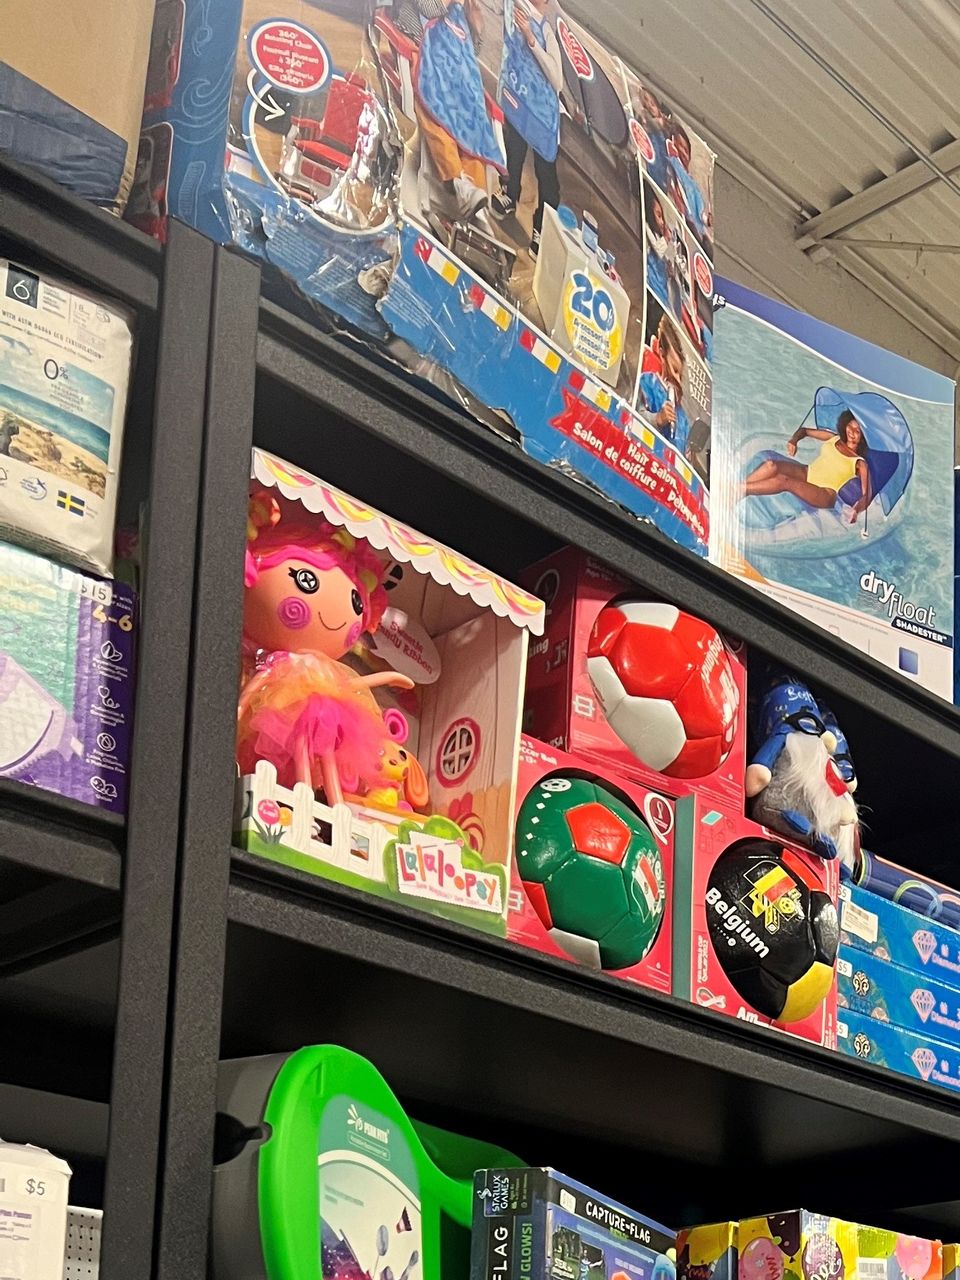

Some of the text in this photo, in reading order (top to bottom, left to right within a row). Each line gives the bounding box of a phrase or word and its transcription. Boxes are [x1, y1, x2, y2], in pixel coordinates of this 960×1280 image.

[13, 279, 30, 300] 6
[571, 271, 615, 332] 20
[44, 358, 69, 380] 0%
[573, 422, 603, 451] Salon
[605, 446, 617, 461] de
[619, 458, 657, 490] coiffure
[627, 442, 650, 466] Hair
[92, 605, 132, 633] 4-6
[705, 887, 770, 959] Belgium
[25, 1177, 46, 1197] $5
[492, 1175, 501, 1212] STARLUX
[500, 1177, 509, 1209] GAMES
[585, 1201, 626, 1232] CAPTURE
[630, 1223, 651, 1244] FLAG
[521, 1223, 533, 1272] GLOWS!
